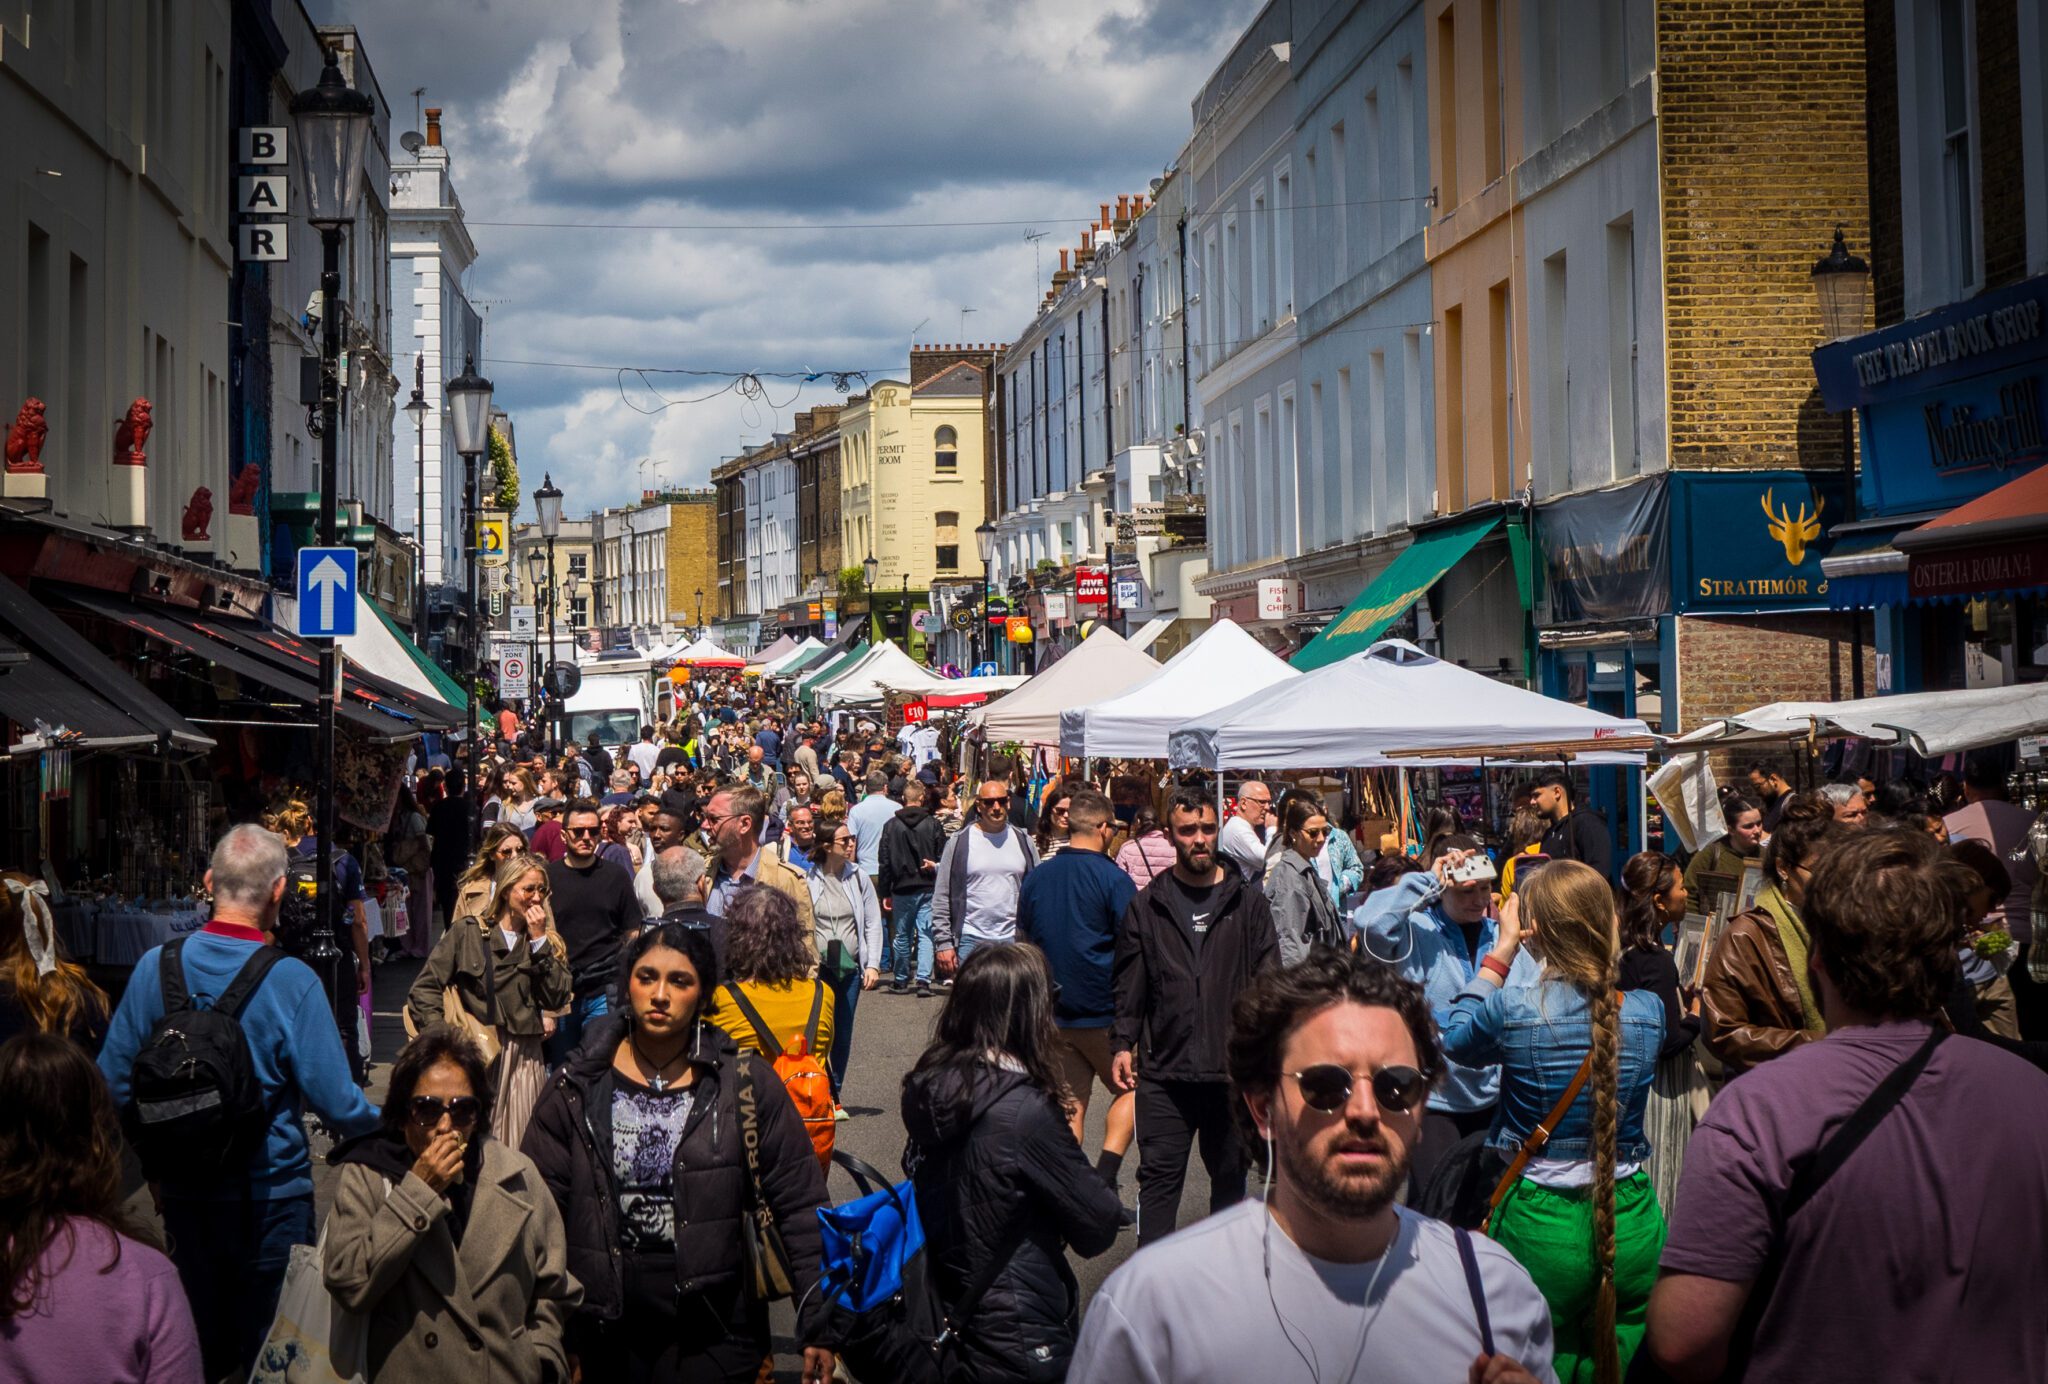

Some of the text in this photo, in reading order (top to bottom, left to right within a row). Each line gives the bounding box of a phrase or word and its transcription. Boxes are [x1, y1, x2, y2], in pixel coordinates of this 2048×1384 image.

[247, 132, 278, 255] BAR
[1852, 299, 2040, 387] THE TRAVEL BOOK SHOP
[1923, 376, 2043, 471] Notting Hill
[879, 456, 901, 464] ROOM
[1081, 579, 1103, 587] FIVE
[1914, 553, 2031, 588] OSTERIA ROMANA
[1700, 576, 1808, 596] STRATHMÓR
[908, 705, 925, 719] £10
[1594, 728, 1616, 739] Master
[738, 1084, 759, 1169] ROMA
